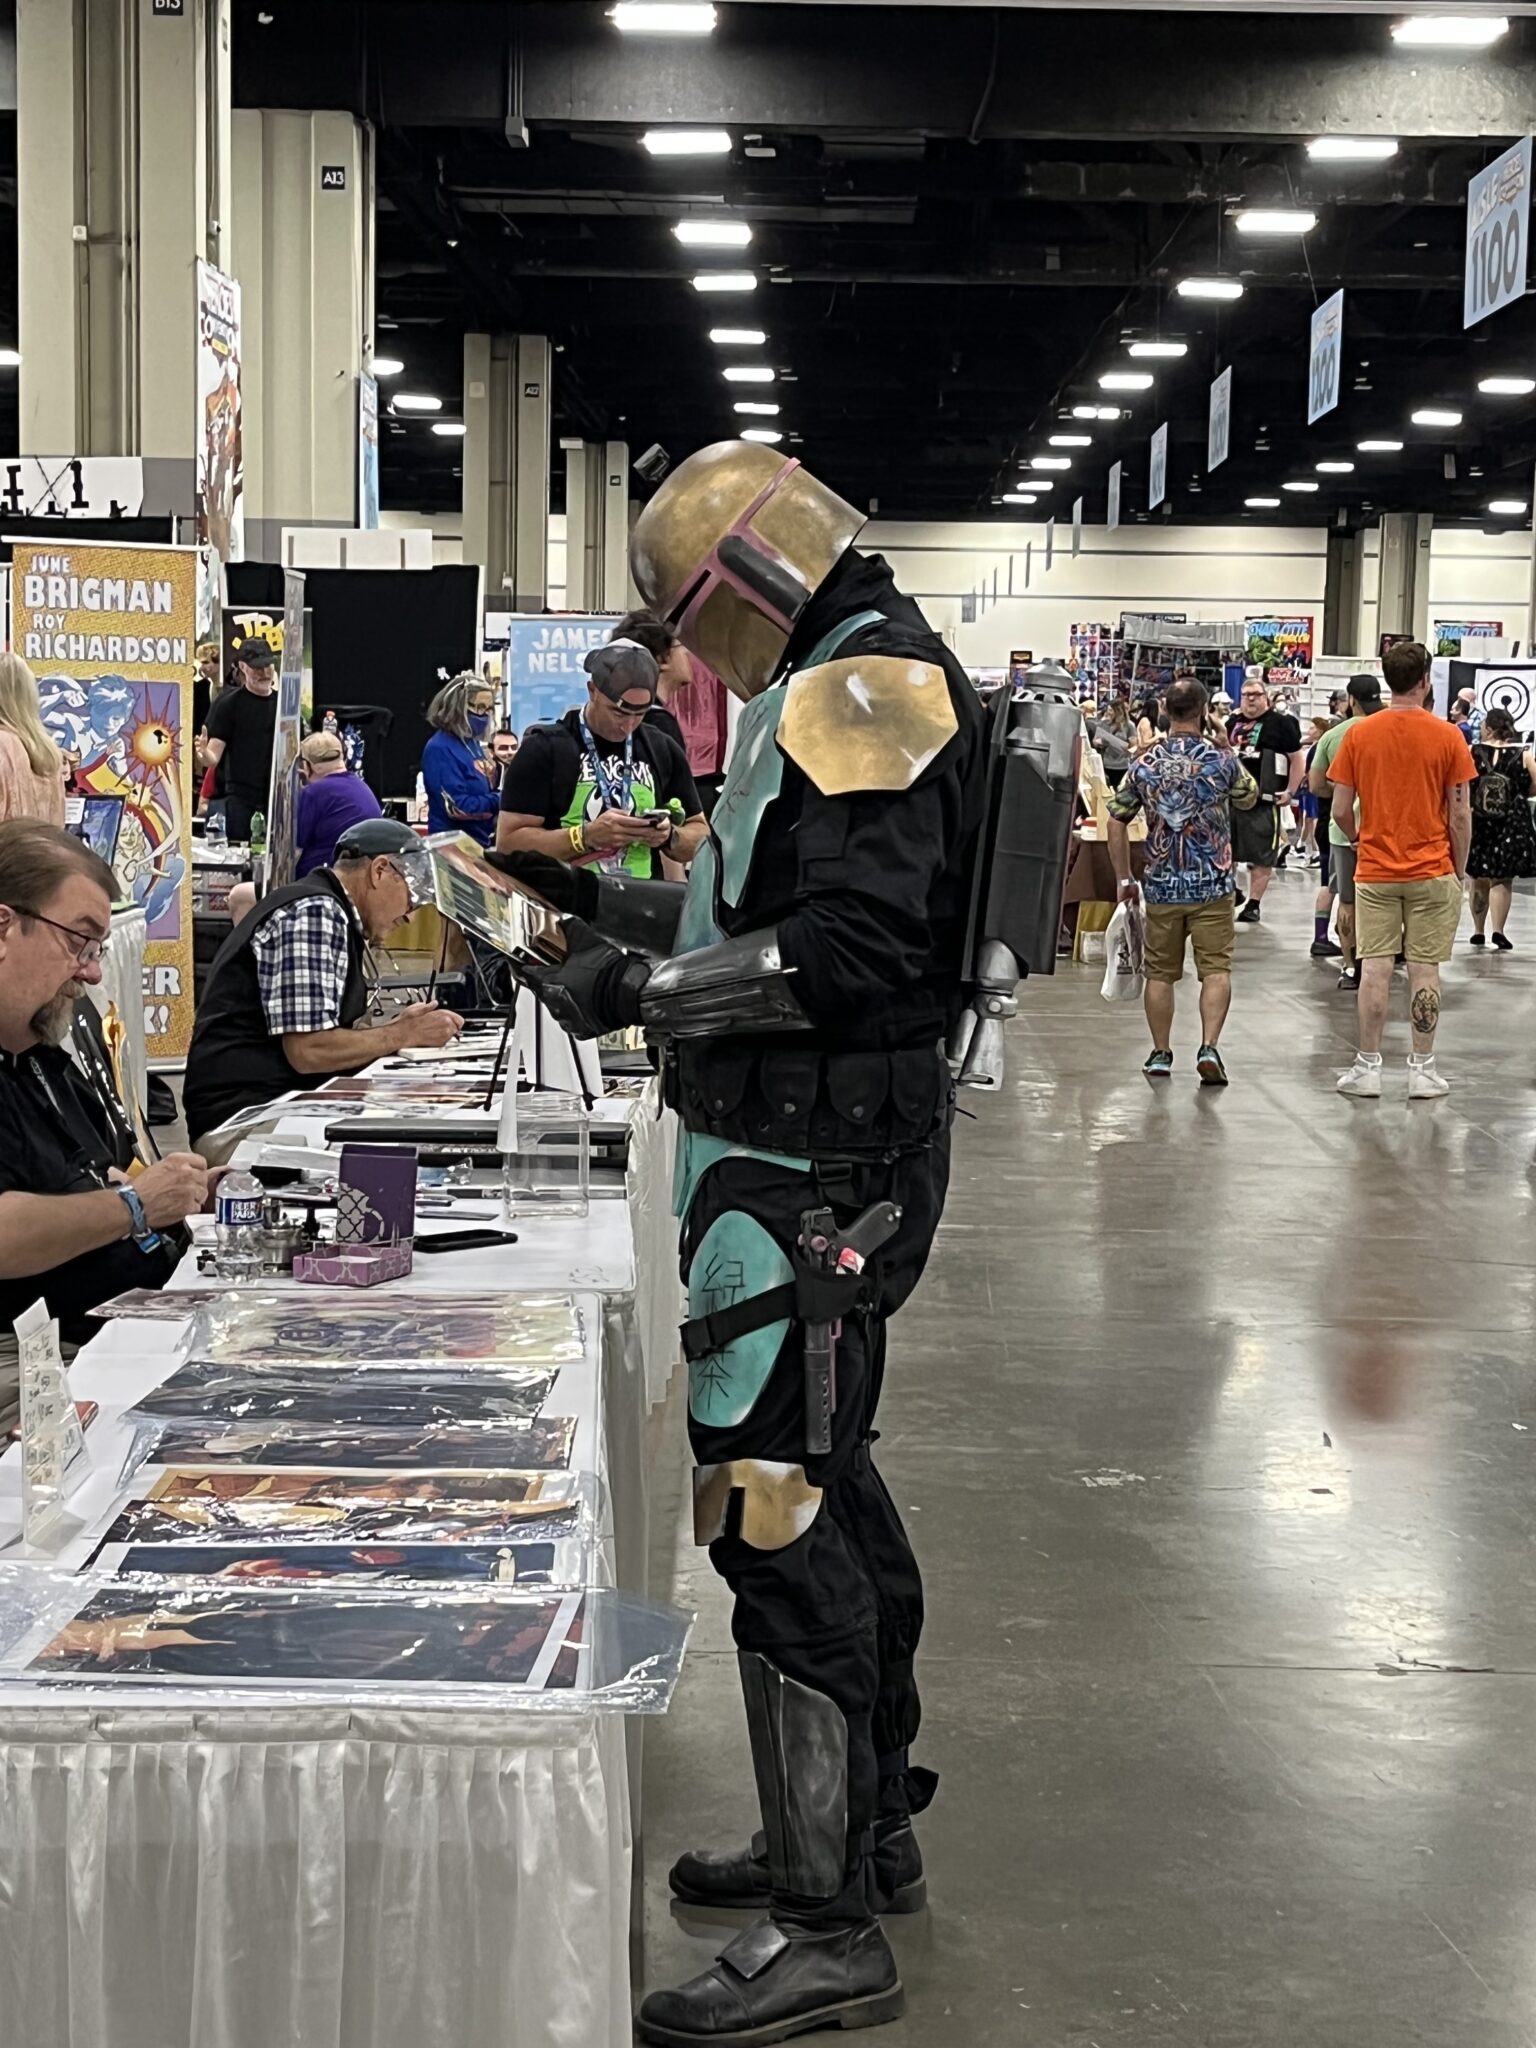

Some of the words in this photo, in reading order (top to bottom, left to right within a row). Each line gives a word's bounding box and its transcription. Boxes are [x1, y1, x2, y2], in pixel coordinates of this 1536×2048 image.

[323, 171, 345, 185] A13
[1472, 208, 1520, 313] 1100
[31, 555, 71, 573] JUNE
[24, 576, 172, 613] BRIGMAN
[33, 613, 65, 630] ROY
[1249, 622, 1309, 637] CHARLOTTE
[25, 633, 188, 664] RICHARDSON
